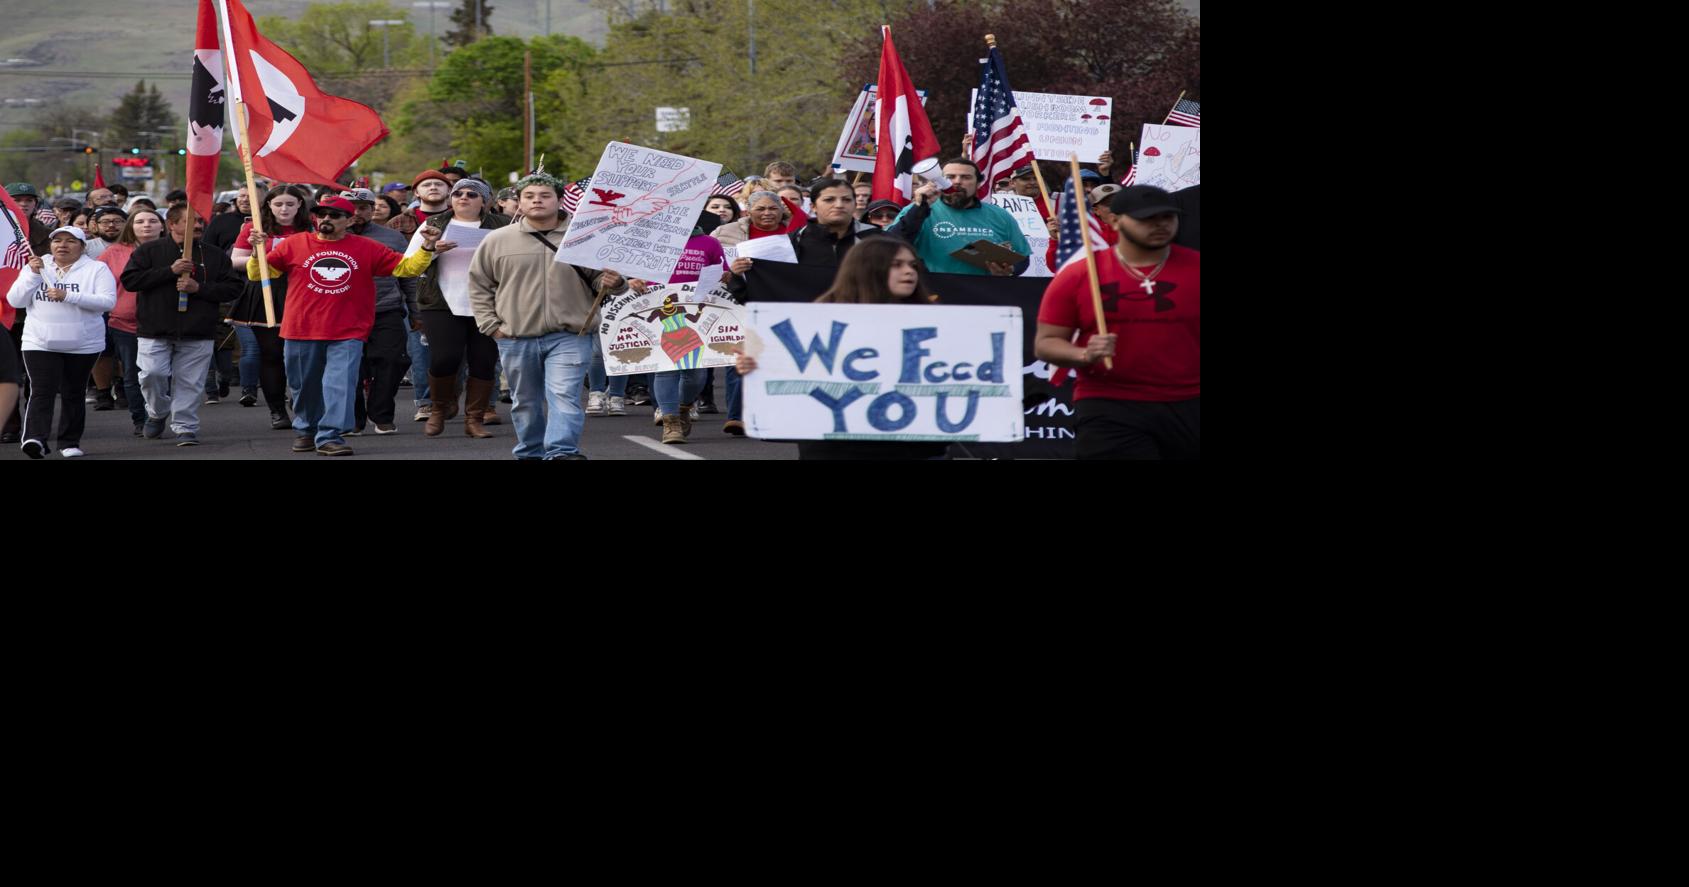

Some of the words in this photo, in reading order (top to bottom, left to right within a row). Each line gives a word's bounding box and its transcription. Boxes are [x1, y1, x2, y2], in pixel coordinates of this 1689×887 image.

[608, 144, 639, 162] WE
[642, 152, 685, 170] NEED
[616, 160, 657, 179] YOUR
[594, 170, 658, 193] SUPPORT
[666, 173, 708, 197] SEATTLE
[651, 212, 682, 225] ARE
[667, 204, 691, 217] WE
[607, 233, 653, 250] UNION
[623, 225, 652, 239] FOR
[657, 233, 672, 243] A
[302, 254, 315, 268] UFW
[316, 250, 359, 270] FOUNDATION
[595, 244, 679, 274] OSTROM
[601, 322, 610, 335] NO
[681, 284, 697, 293] DE
[616, 332, 640, 342] HAY
[620, 326, 633, 334] NO
[717, 325, 739, 334] SIN
[608, 340, 651, 350] JUSTICIA
[770, 318, 880, 382] We
[808, 385, 980, 434] YOU
